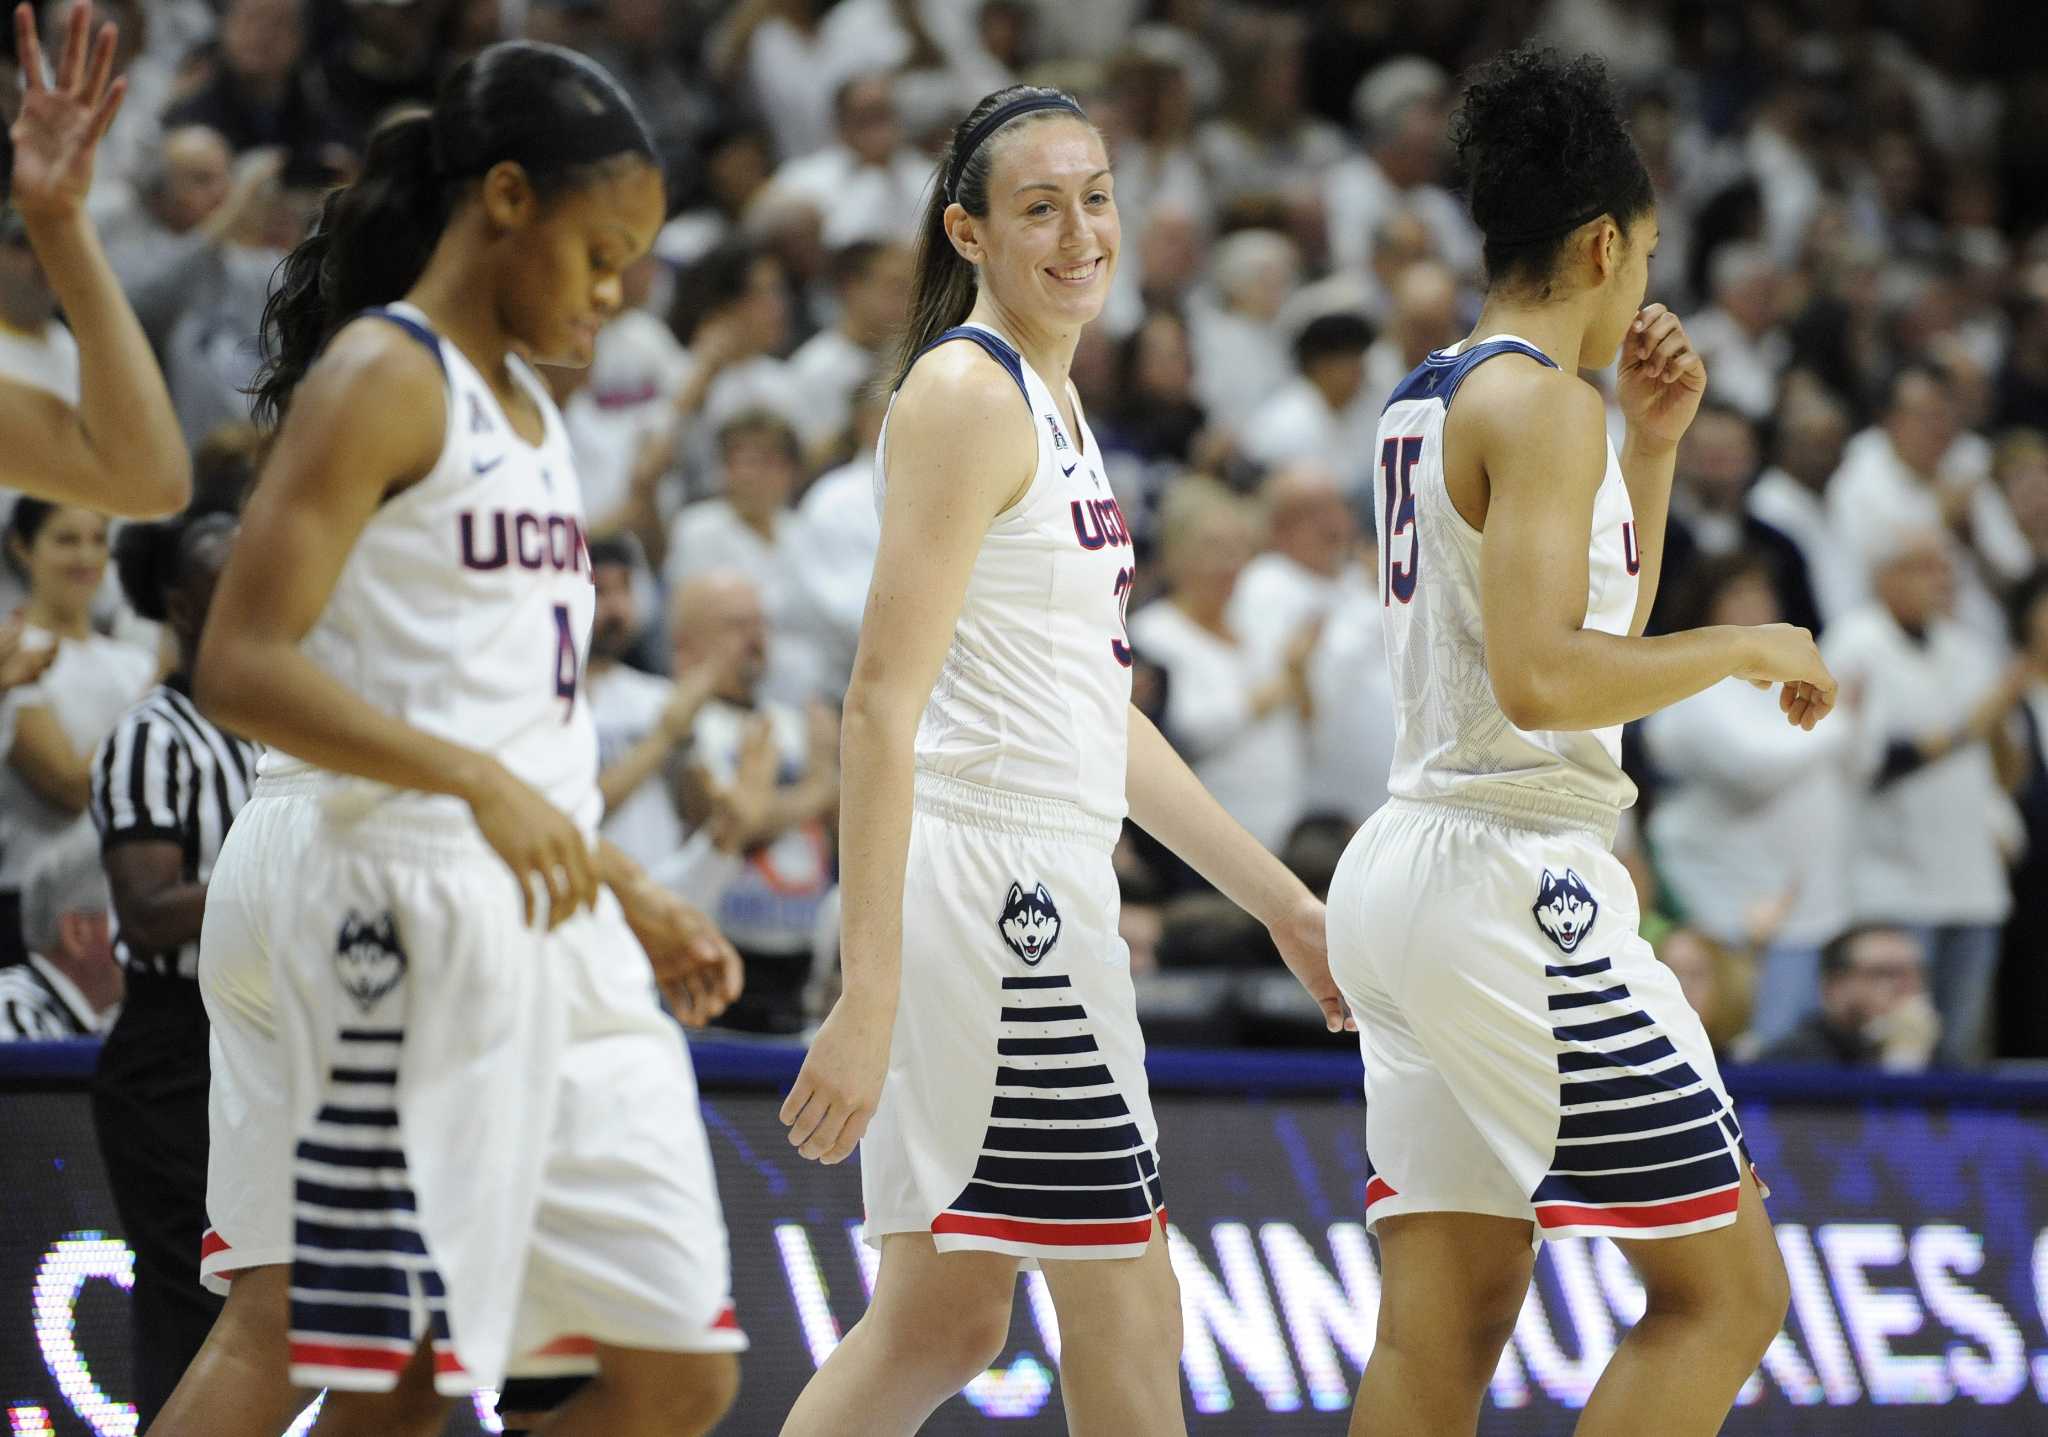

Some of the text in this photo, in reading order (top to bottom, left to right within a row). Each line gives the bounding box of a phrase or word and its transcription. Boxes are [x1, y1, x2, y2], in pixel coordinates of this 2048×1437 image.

[459, 512, 595, 584] UCON
[1381, 436, 1423, 607] 15
[552, 604, 577, 725] 4
